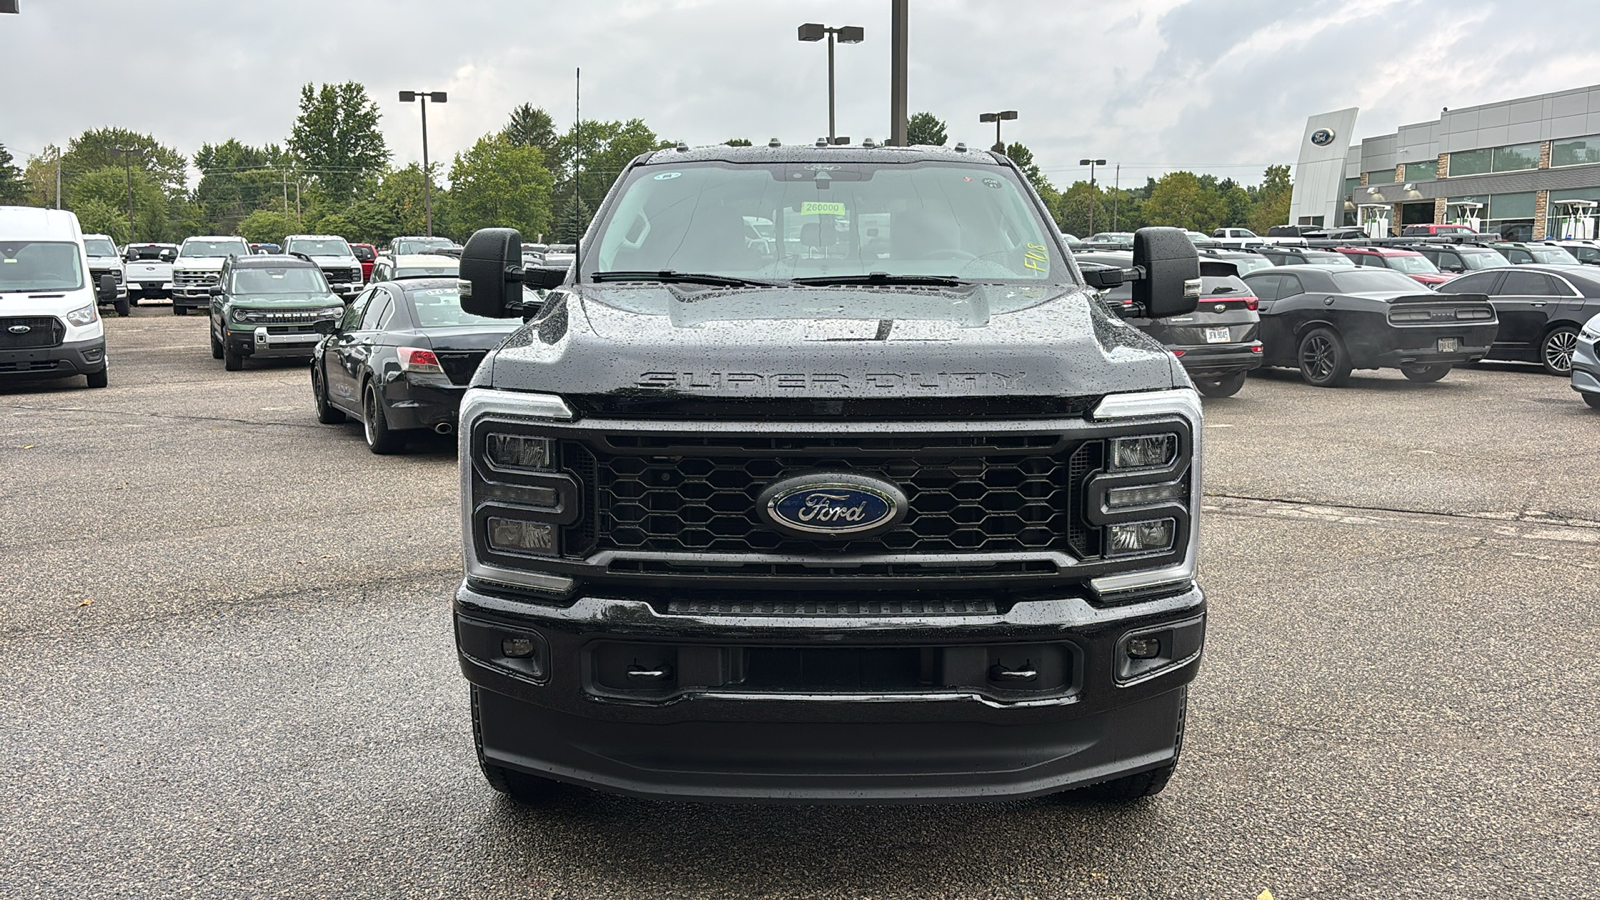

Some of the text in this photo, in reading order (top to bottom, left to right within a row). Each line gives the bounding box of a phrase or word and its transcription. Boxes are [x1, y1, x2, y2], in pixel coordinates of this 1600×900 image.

[806, 203, 839, 212] 260000
[638, 371, 1027, 391] SUPER DUTY
[798, 493, 867, 522] Ford
